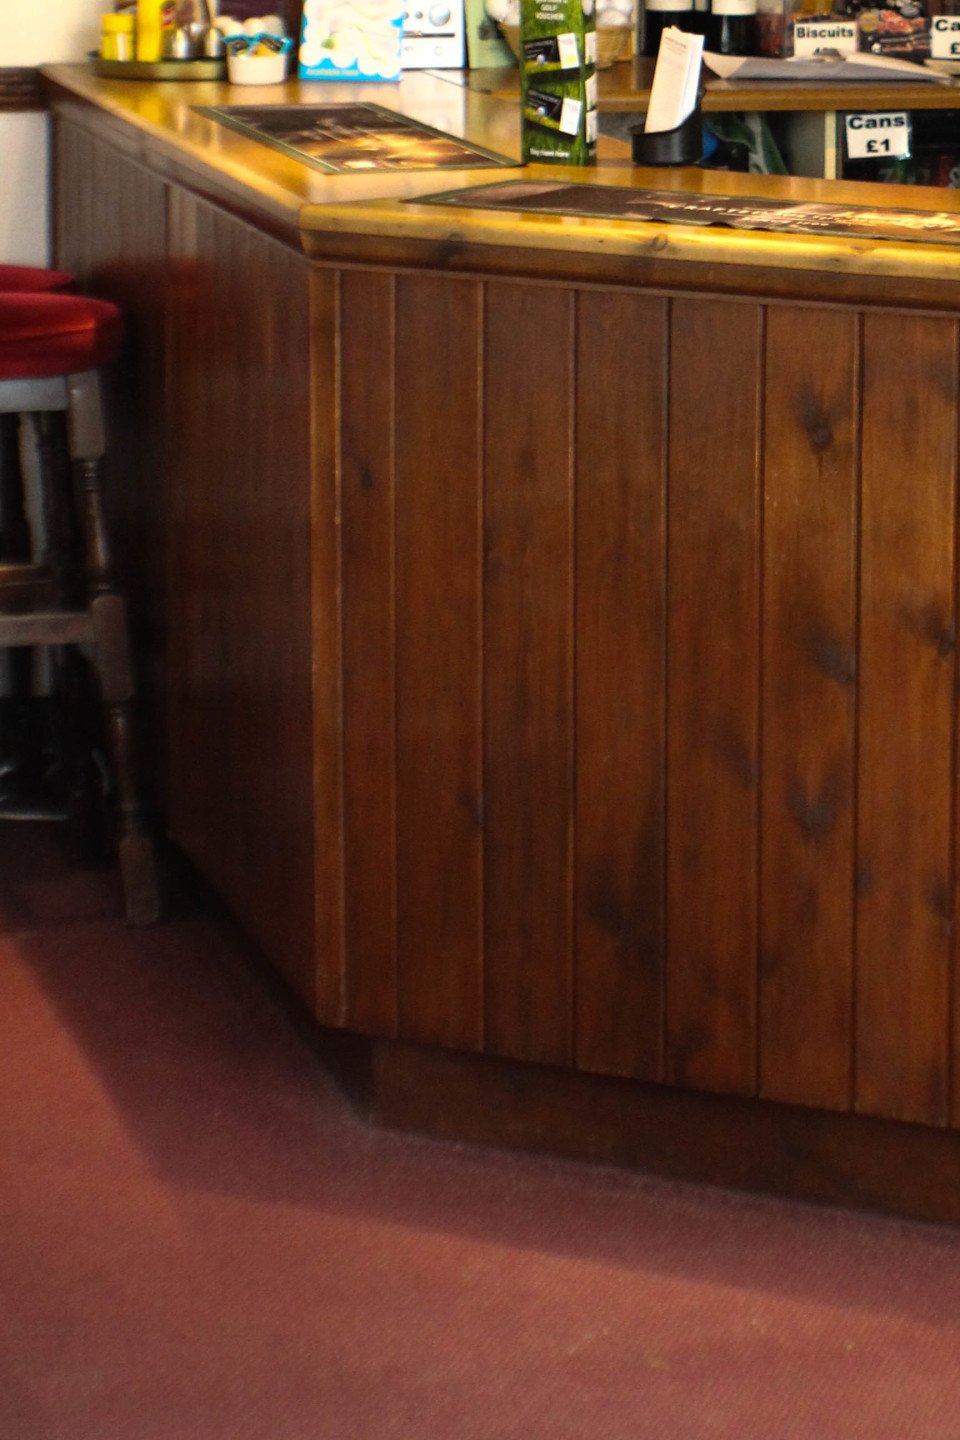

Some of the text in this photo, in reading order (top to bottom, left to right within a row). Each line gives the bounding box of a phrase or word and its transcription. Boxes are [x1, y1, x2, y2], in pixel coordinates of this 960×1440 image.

[795, 26, 854, 39] Biscuits
[847, 117, 905, 130] Cans
[865, 138, 891, 153] £1
